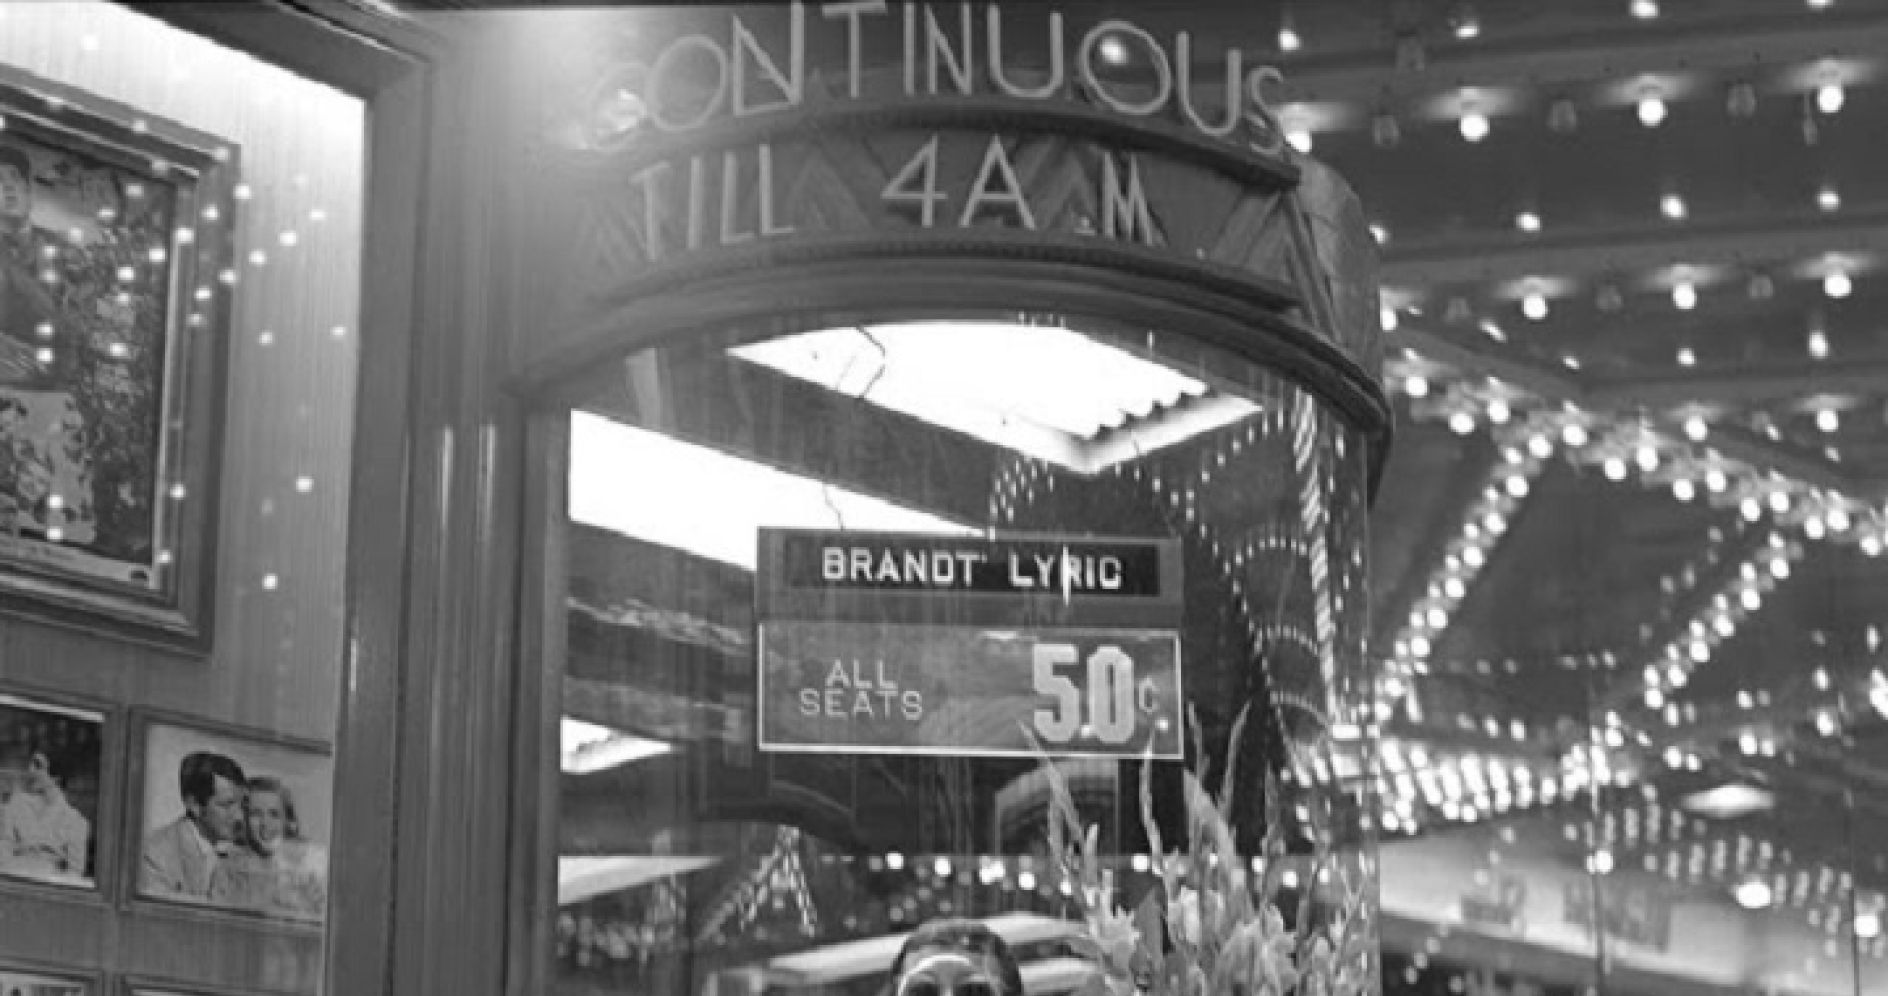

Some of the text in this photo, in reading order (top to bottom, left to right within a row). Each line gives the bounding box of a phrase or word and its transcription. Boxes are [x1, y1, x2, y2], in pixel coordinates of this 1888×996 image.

[628, 142, 797, 263] TILL
[1007, 551, 1122, 590] LYRIC
[824, 658, 899, 691] ALL
[799, 688, 923, 721] SEATS
